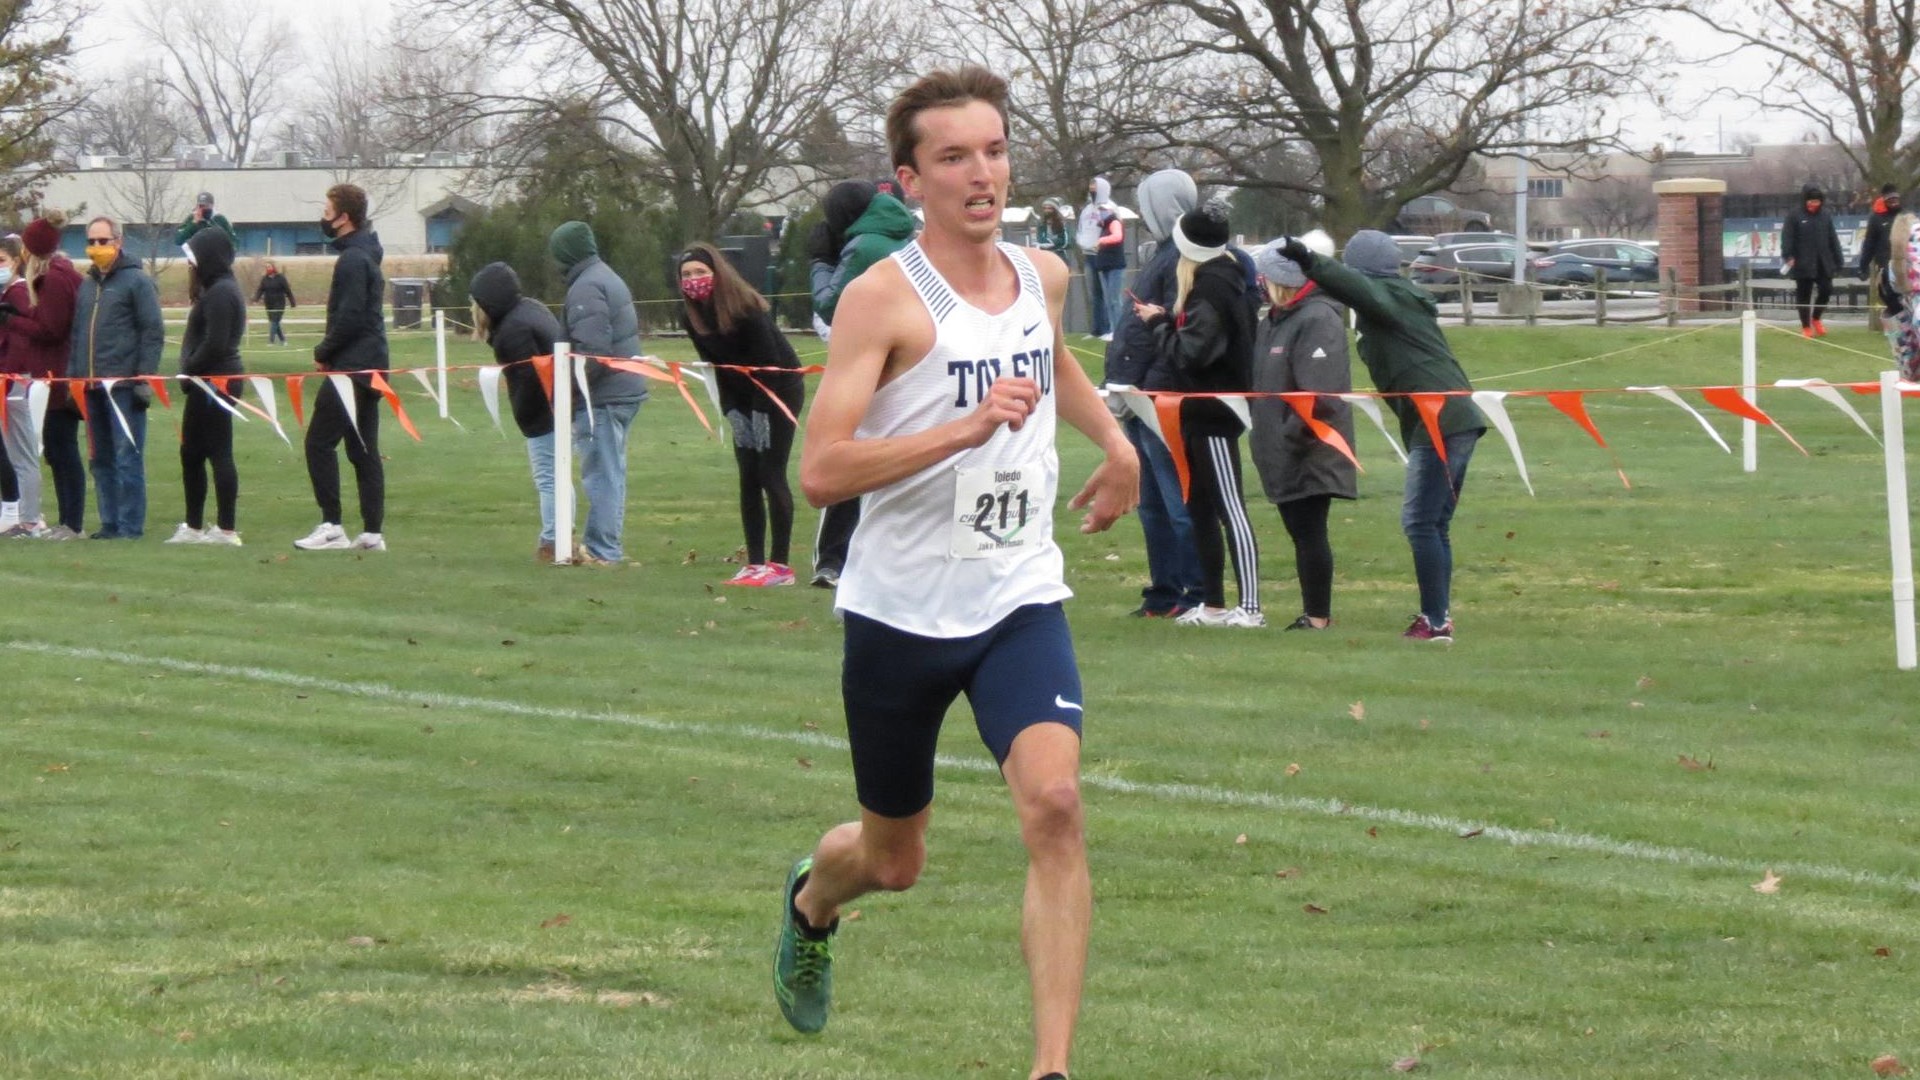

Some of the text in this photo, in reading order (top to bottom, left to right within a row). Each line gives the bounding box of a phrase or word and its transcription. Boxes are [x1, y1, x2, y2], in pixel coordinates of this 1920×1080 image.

[947, 347, 1051, 408] TOEDO
[994, 470, 1021, 482] Toledo
[974, 489, 1028, 532] 211
